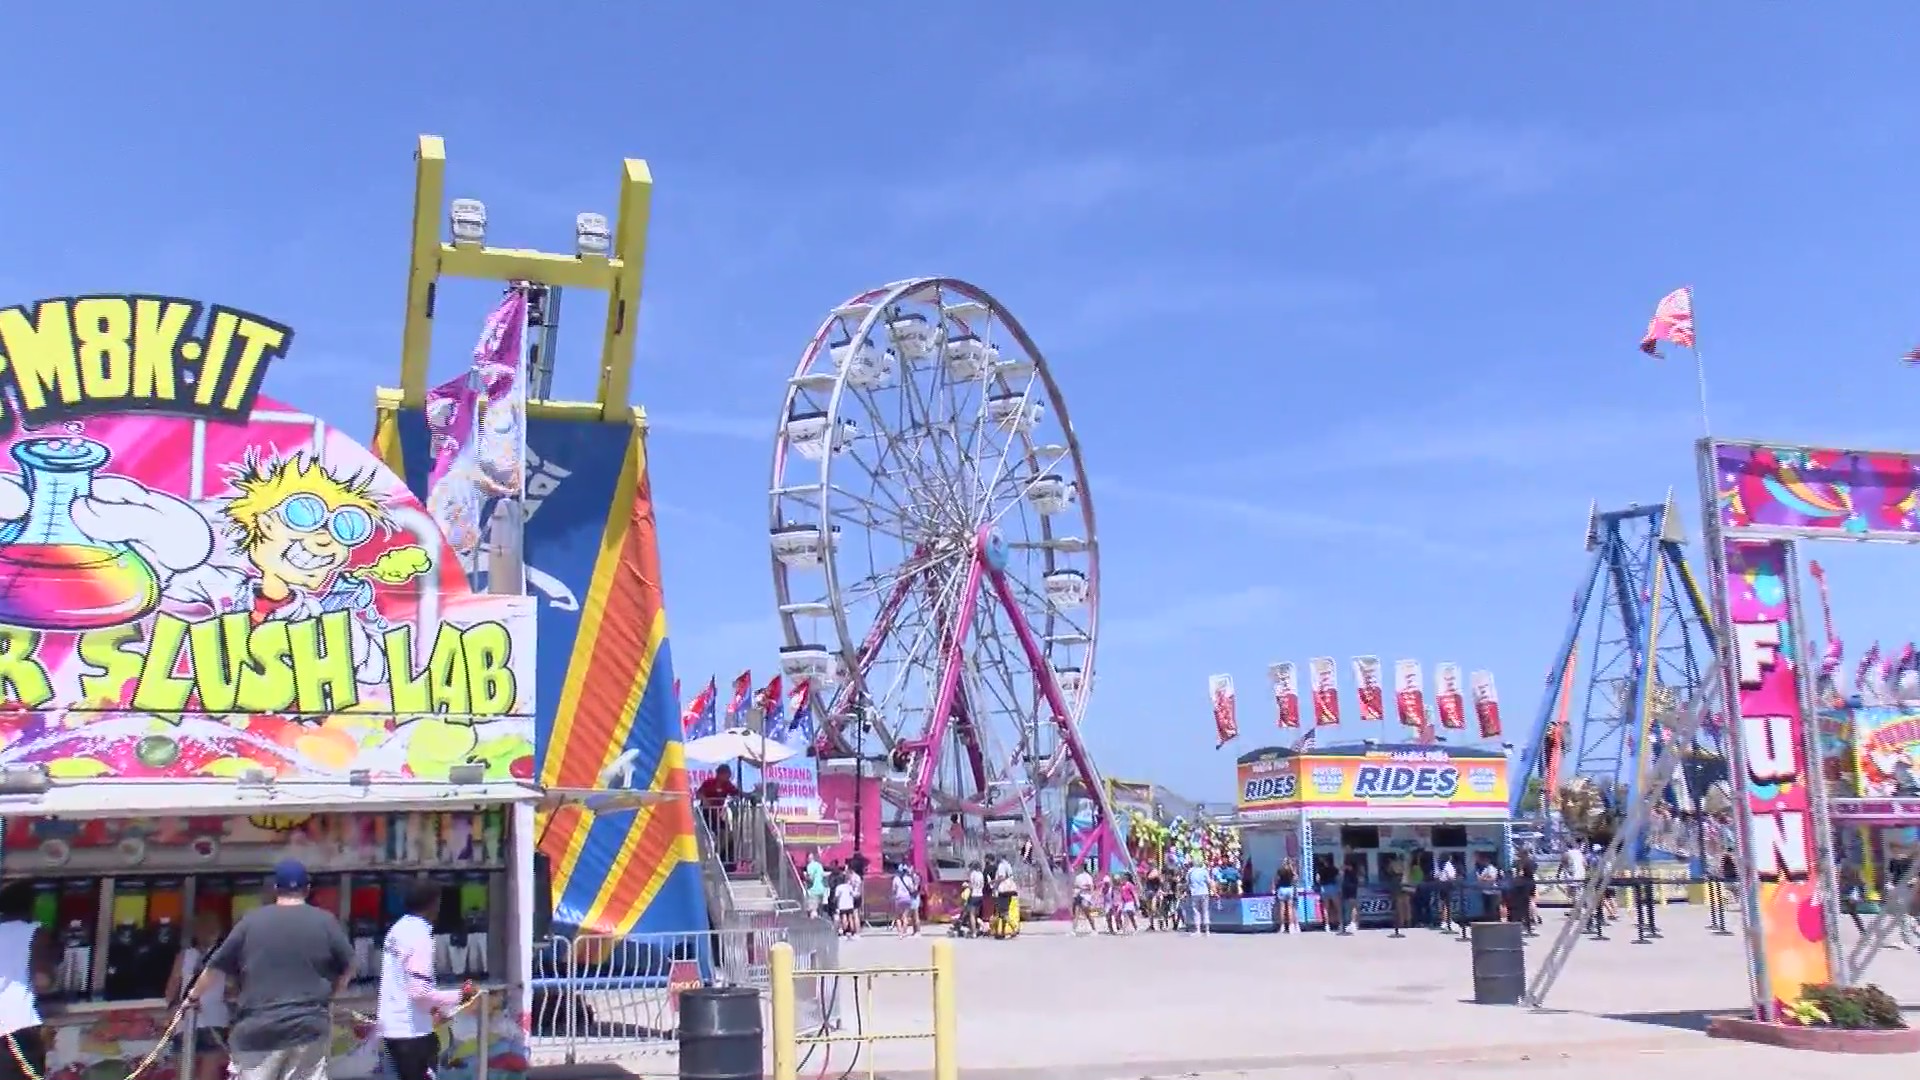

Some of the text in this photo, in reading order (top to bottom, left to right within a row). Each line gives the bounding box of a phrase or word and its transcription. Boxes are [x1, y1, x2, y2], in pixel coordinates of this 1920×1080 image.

[78, 611, 359, 724] SLUSH
[383, 620, 517, 725] LAB
[1734, 620, 1809, 883] FUN
[765, 766, 813, 782] RISTBAND
[1245, 774, 1295, 799] RIDES
[1354, 764, 1458, 798] RIDES
